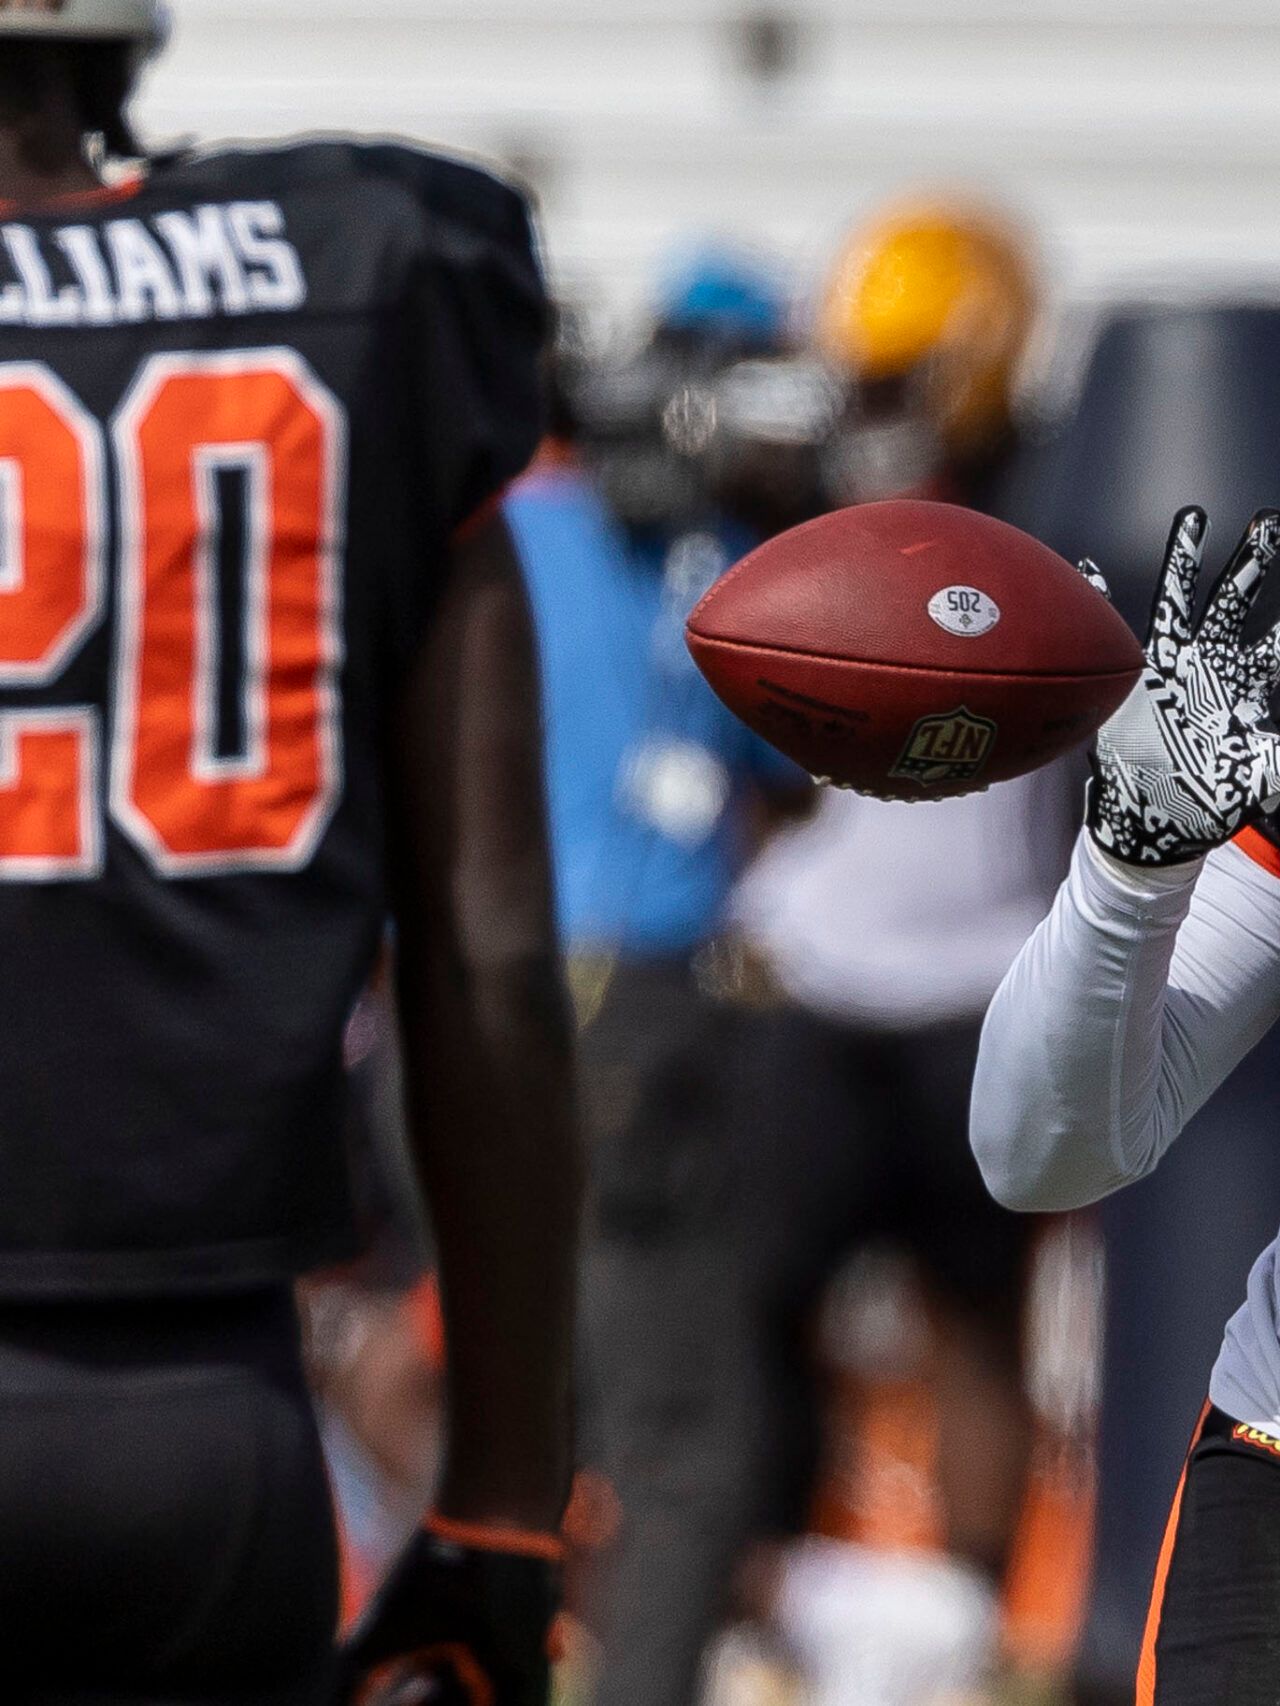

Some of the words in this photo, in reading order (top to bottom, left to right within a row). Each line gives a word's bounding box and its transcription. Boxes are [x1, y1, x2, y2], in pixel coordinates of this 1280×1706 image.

[0, 200, 307, 328] LIAMS
[947, 590, 981, 613] 205
[920, 719, 987, 759] NFL
